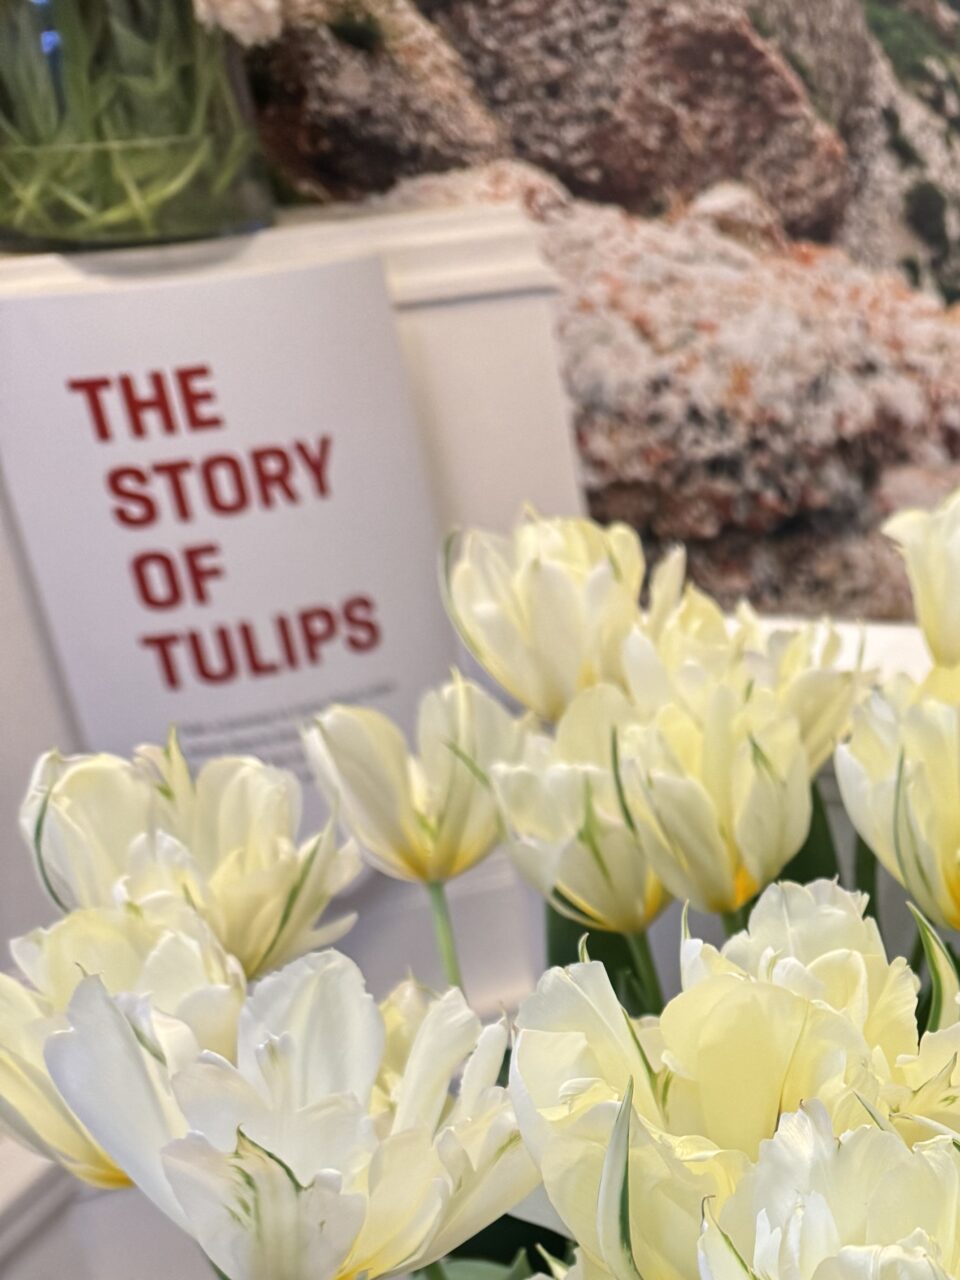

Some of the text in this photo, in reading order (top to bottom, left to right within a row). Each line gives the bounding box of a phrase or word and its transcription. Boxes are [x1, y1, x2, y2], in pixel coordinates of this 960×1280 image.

[67, 364, 224, 443] THE
[106, 436, 333, 529] STORY
[131, 544, 226, 611] OF
[140, 594, 383, 691] TULIPS
